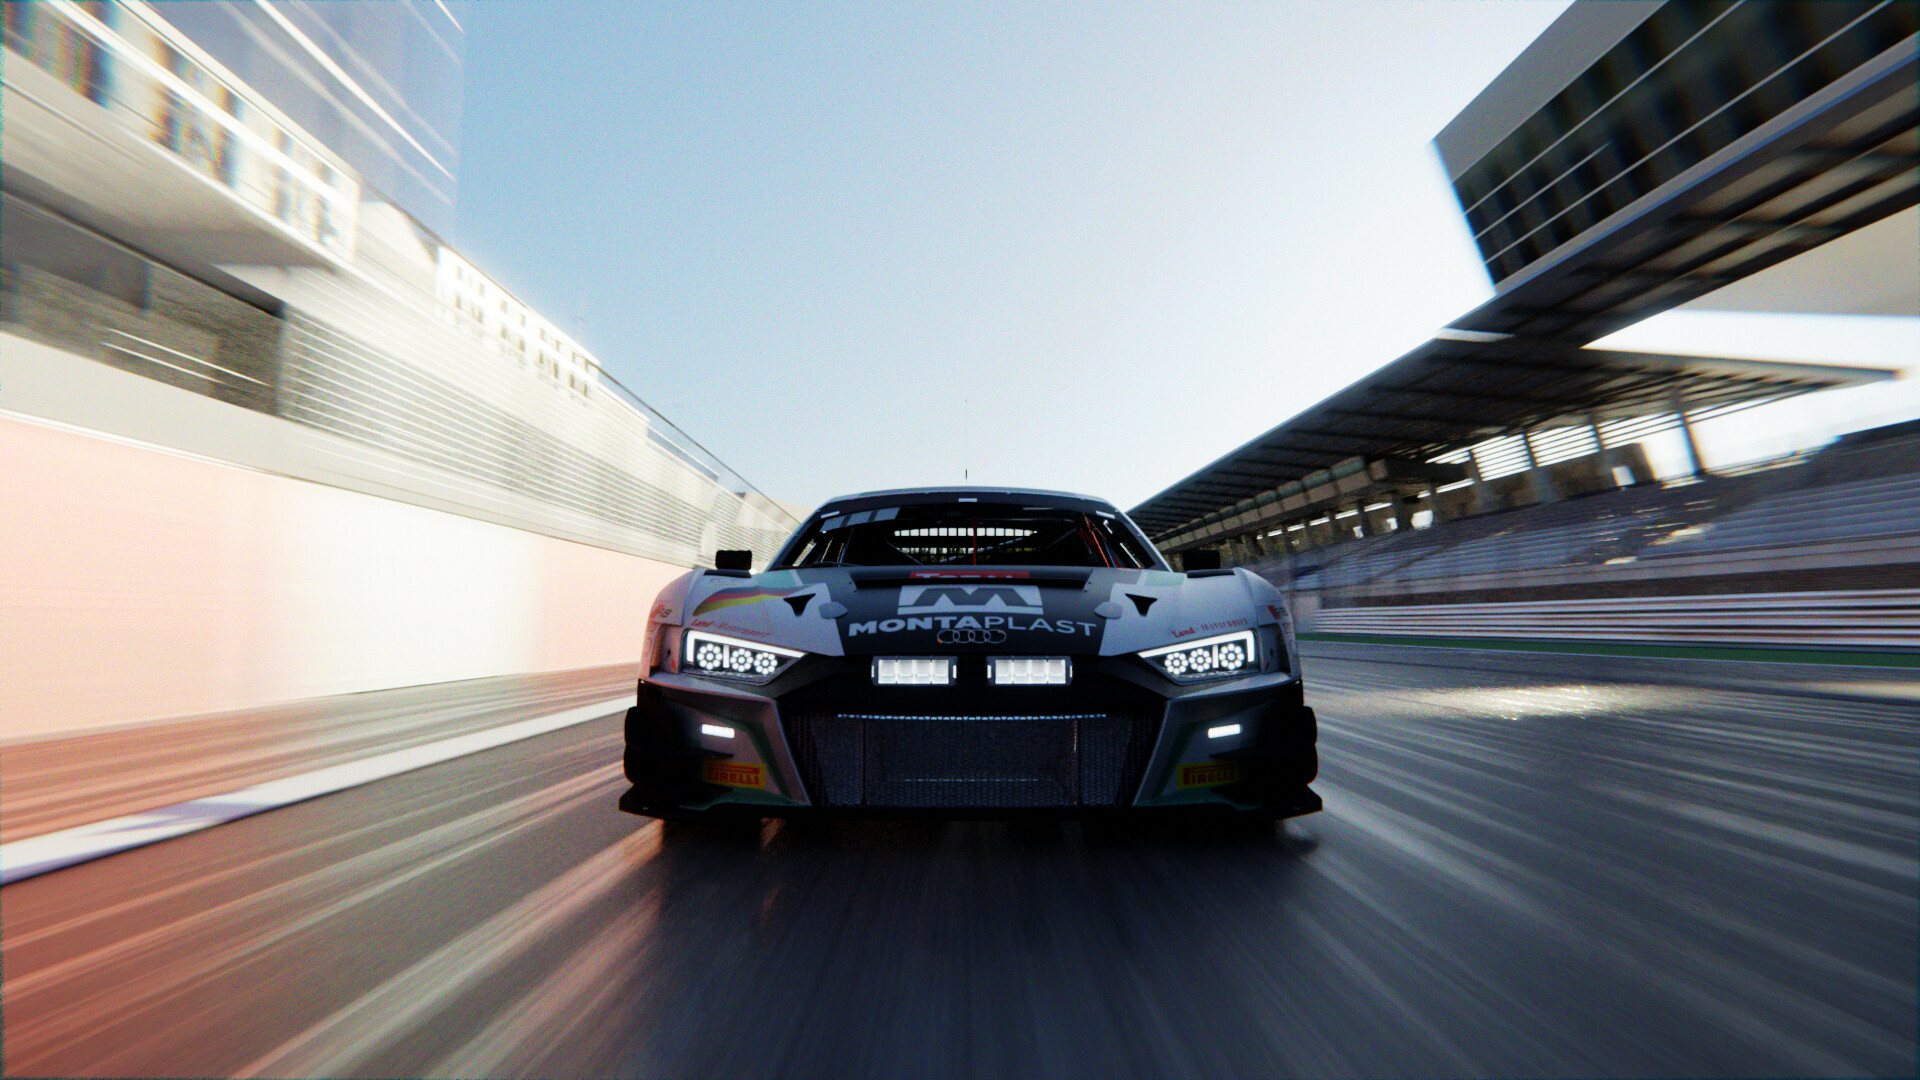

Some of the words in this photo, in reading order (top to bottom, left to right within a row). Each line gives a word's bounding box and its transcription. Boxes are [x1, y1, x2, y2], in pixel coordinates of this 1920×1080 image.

[848, 615, 1098, 637] MONTAPLAST
[707, 763, 760, 785] PIRELLI
[1183, 763, 1234, 785] PIRELLI
